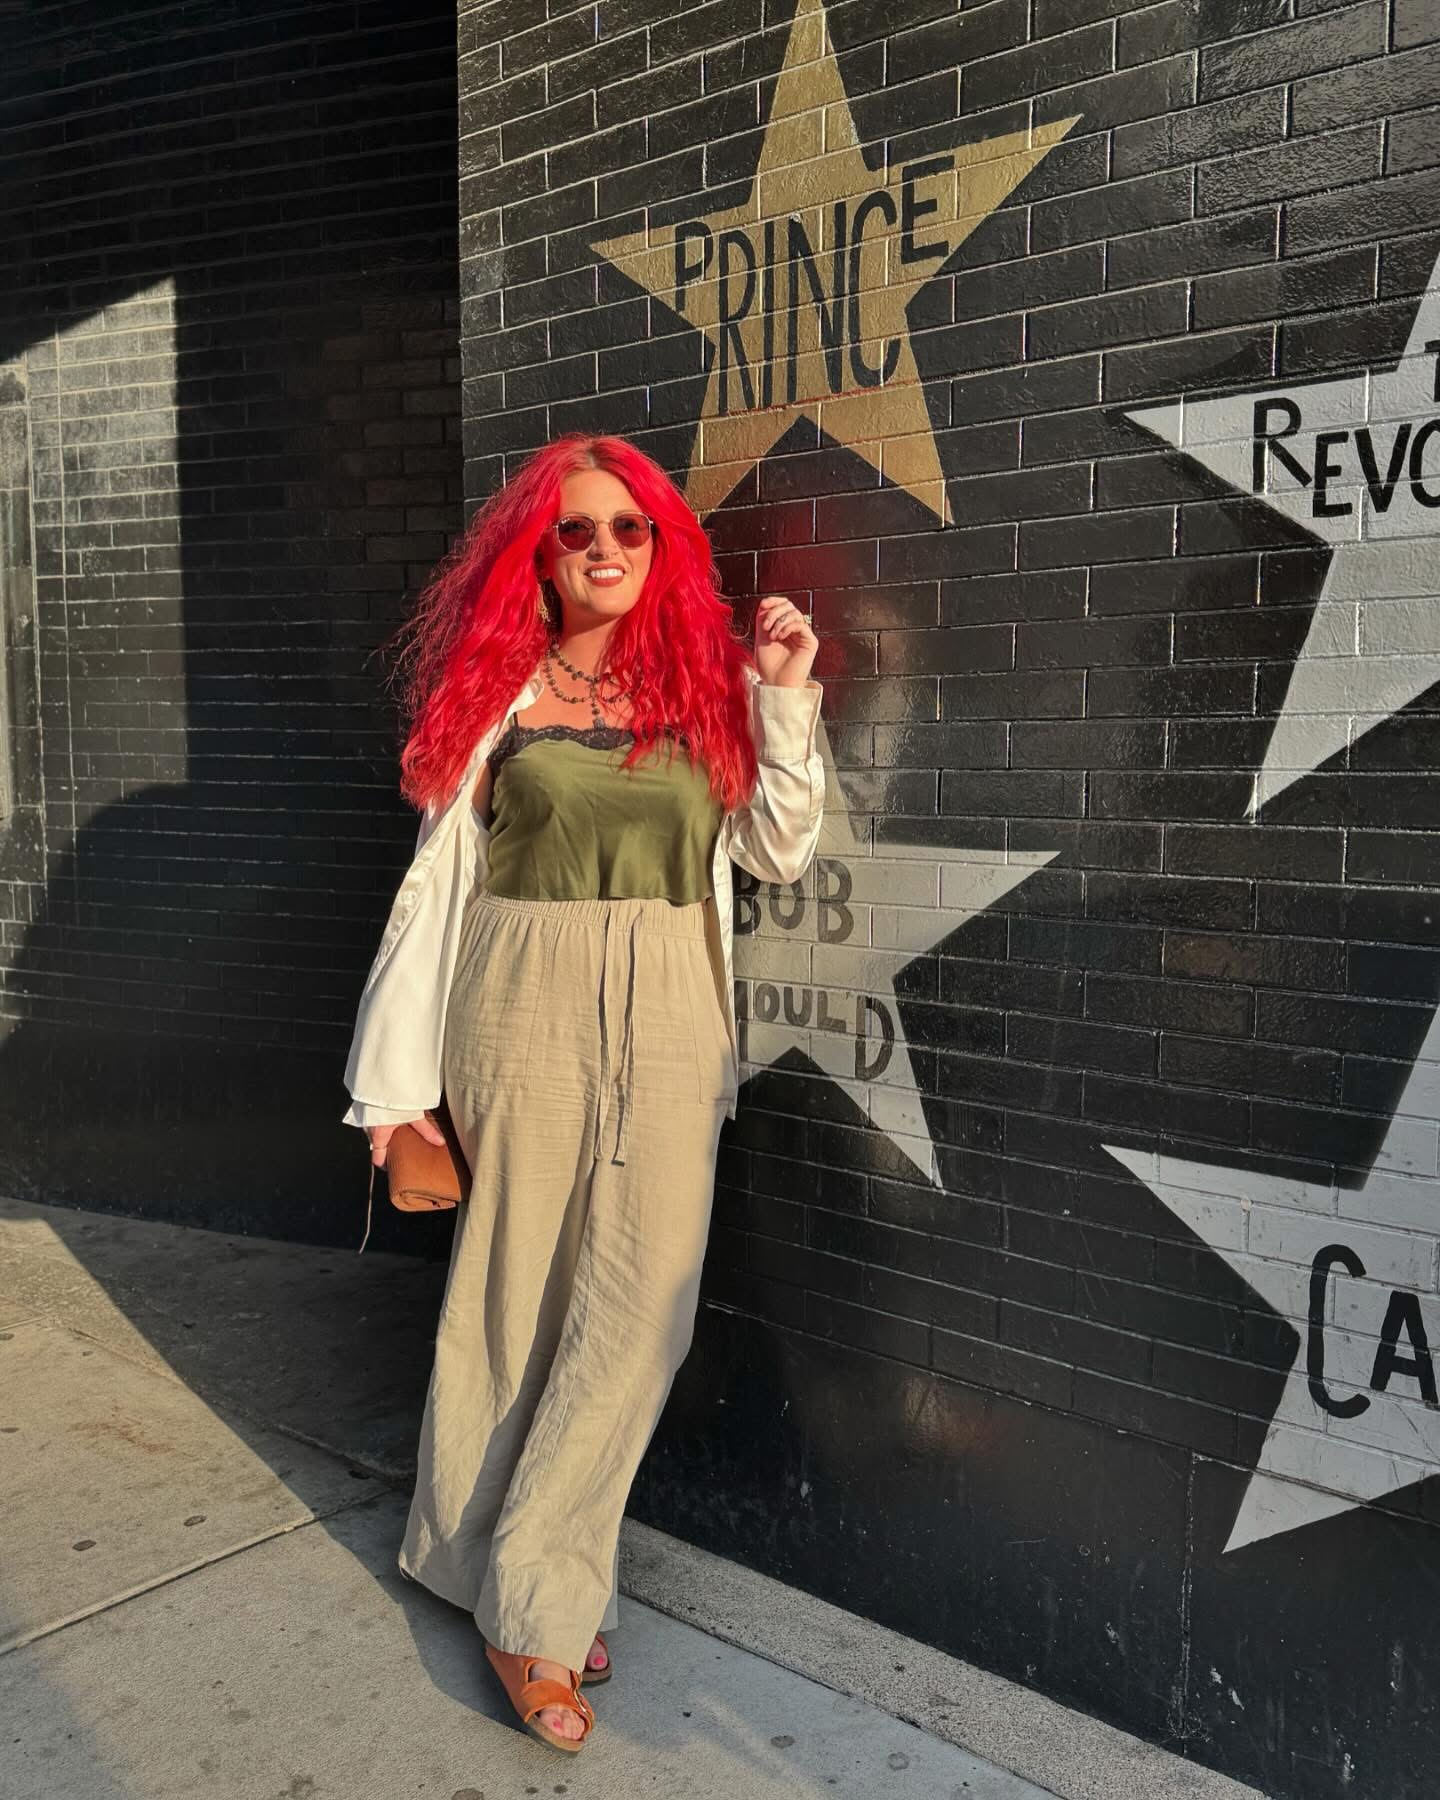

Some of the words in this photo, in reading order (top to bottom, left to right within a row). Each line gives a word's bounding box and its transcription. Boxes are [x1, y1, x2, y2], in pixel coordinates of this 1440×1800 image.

[674, 155, 956, 416] PRINCE
[732, 858, 854, 945] BOB
[734, 979, 895, 1081] OULD
[1307, 1244, 1439, 1419] CA
